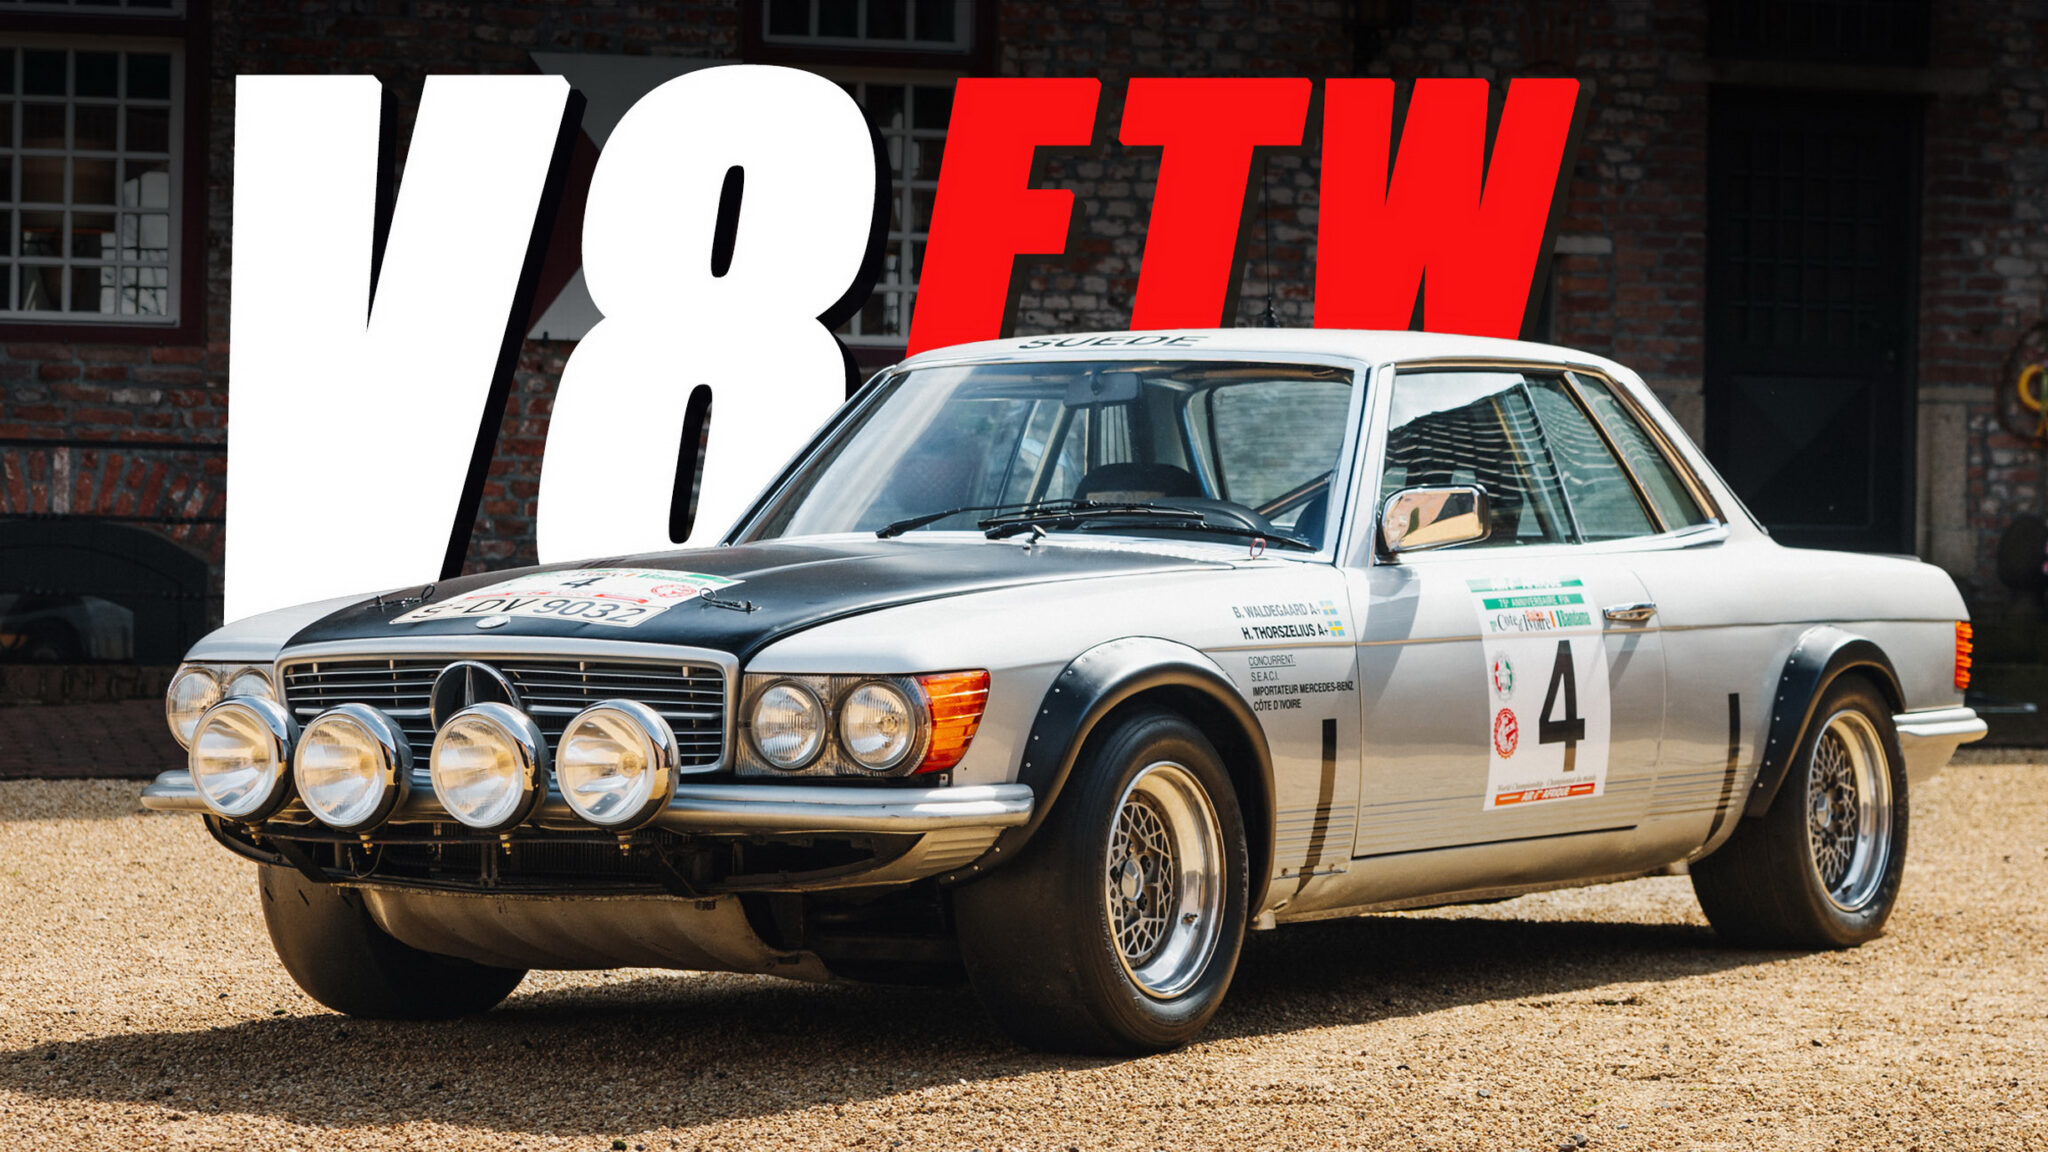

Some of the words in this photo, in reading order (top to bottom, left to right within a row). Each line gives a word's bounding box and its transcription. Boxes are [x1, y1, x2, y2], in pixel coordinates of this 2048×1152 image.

[1019, 335, 1209, 349] SUEDE
[560, 577, 604, 589] 4
[532, 599, 647, 623] 9032
[1232, 606, 1244, 618] B.
[1243, 602, 1308, 618] WALDEGAARD
[1241, 626, 1254, 640] H.
[1252, 623, 1316, 640] THORSZELIUS
[1253, 684, 1299, 697] IMPORTATEUR
[1299, 681, 1354, 694] MERCEDES-BENZ
[1254, 699, 1272, 711] CÔTE
[1539, 639, 1585, 772] 4
